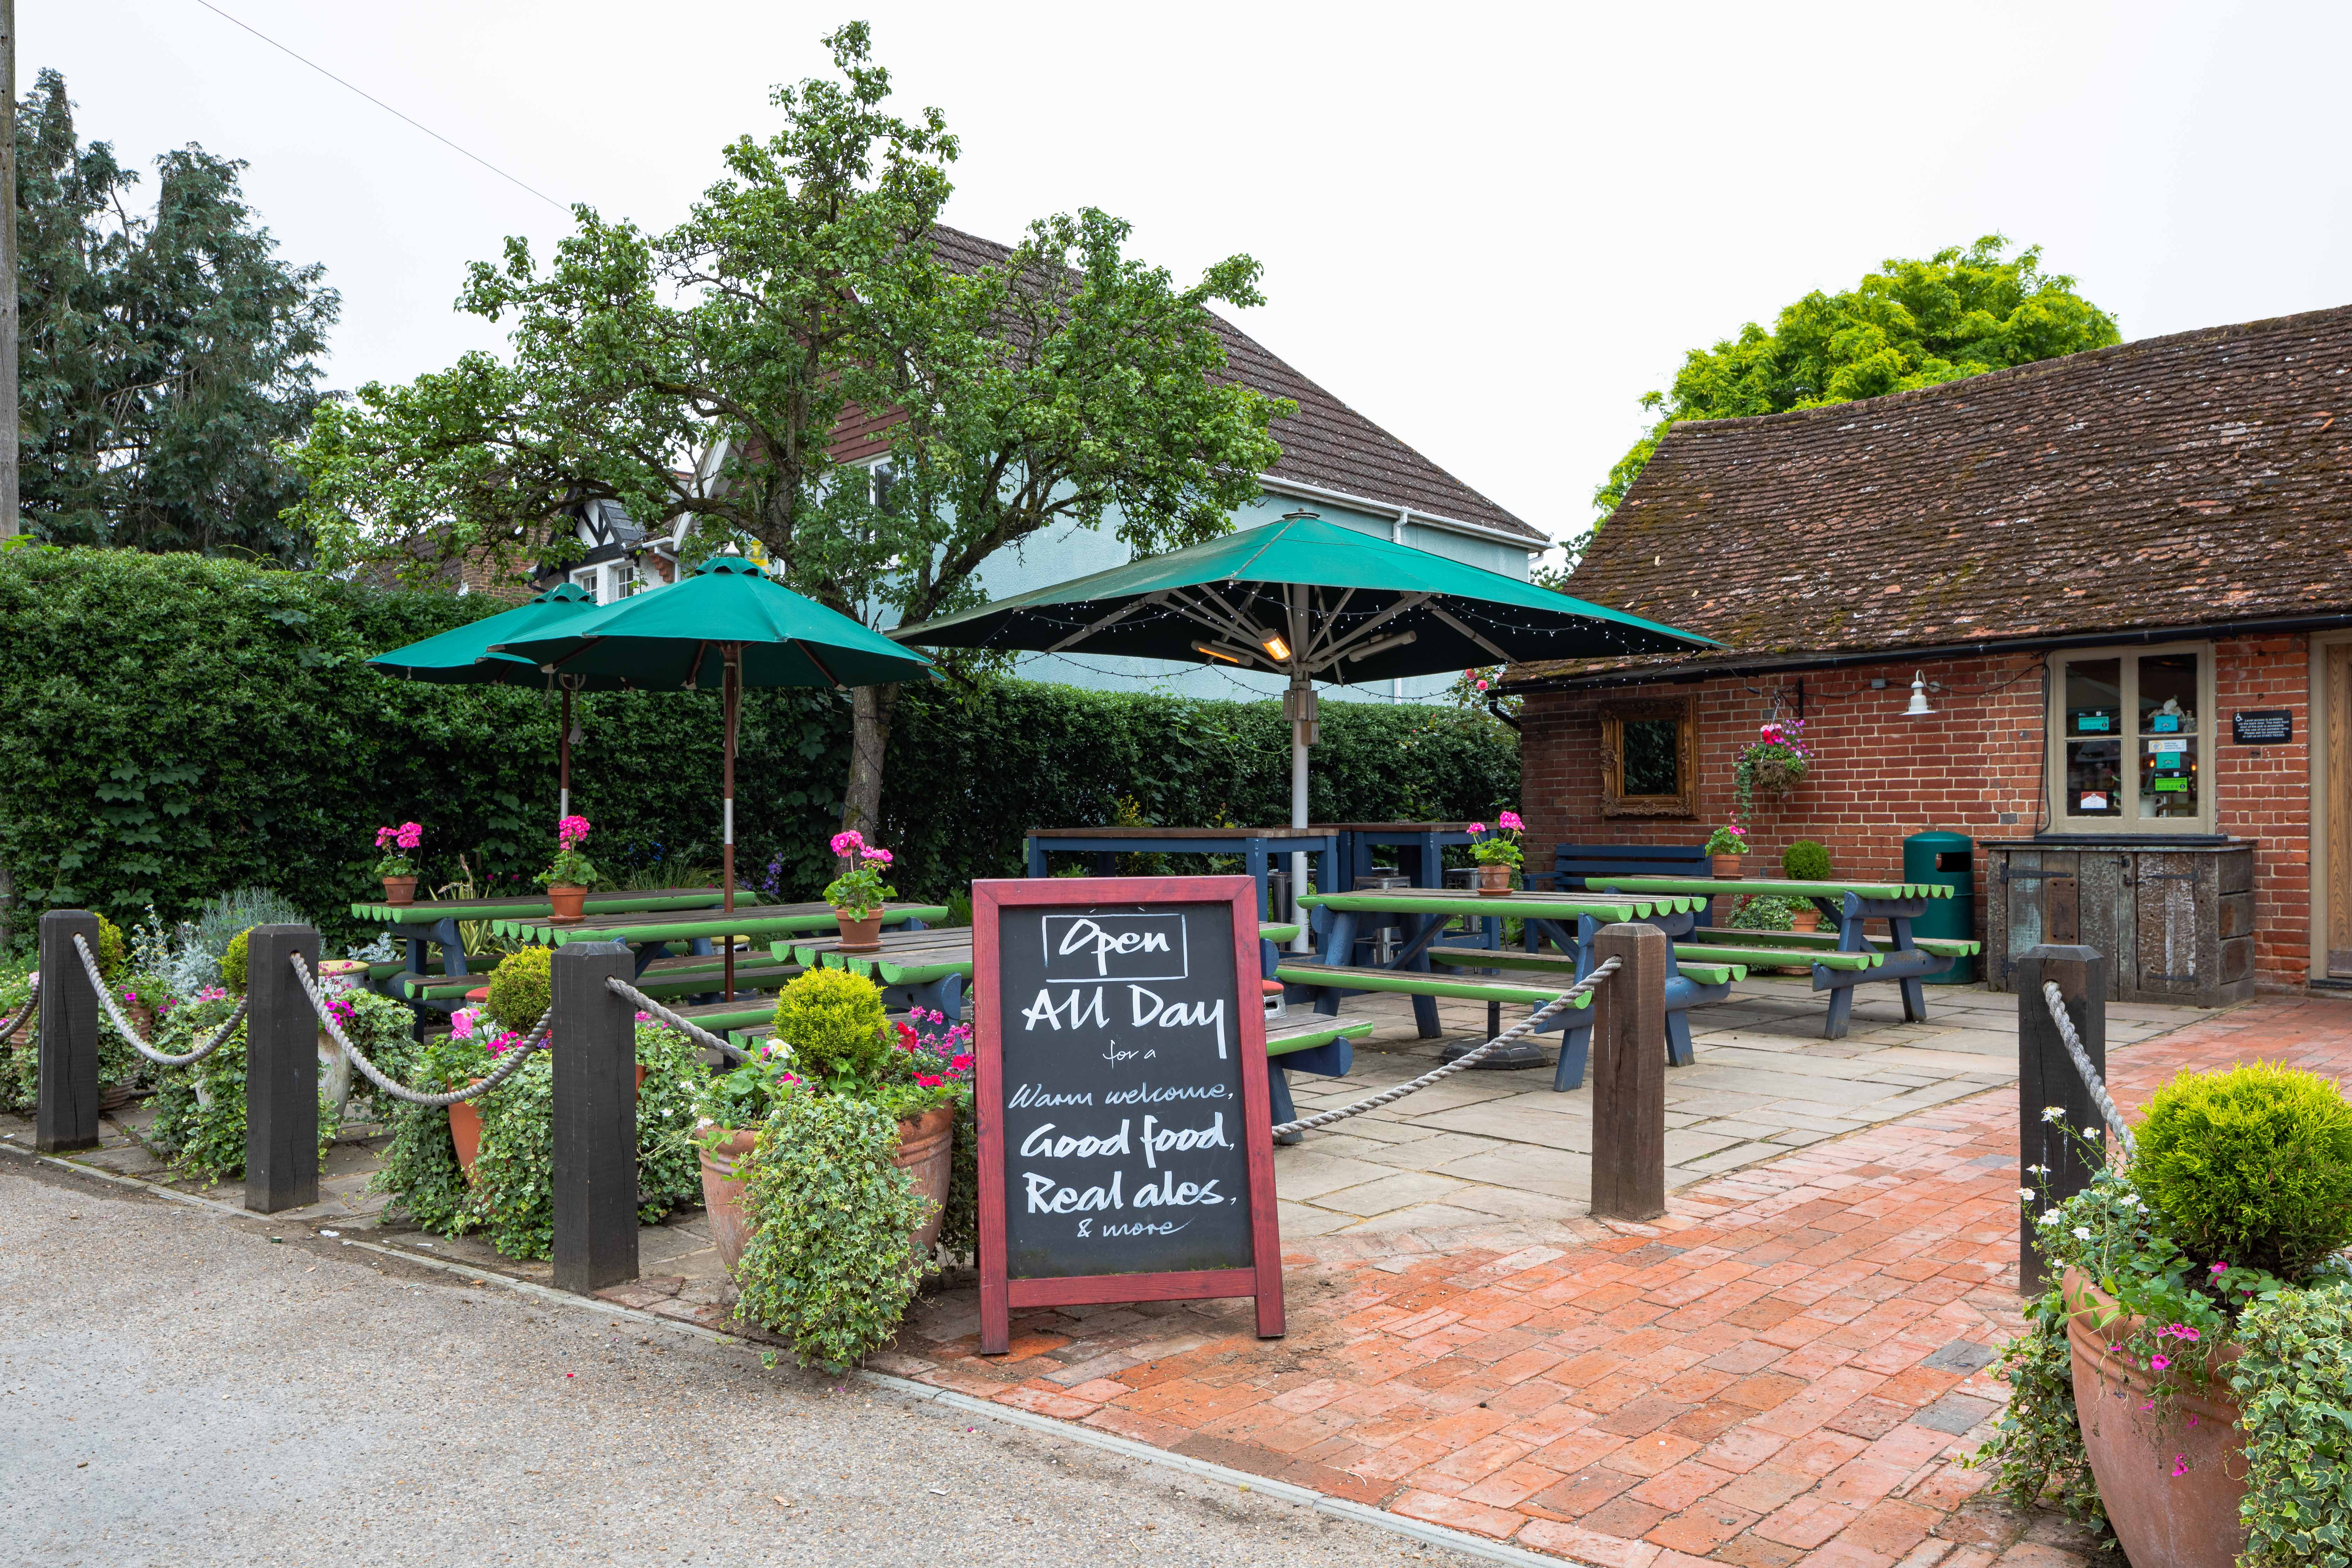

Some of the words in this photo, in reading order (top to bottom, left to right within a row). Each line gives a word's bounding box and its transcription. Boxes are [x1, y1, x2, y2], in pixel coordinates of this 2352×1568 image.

[1058, 918, 1171, 976] Open
[1022, 986, 1111, 1031] All
[1128, 984, 1227, 1059] Day
[1103, 1039, 1140, 1069] for
[1144, 1049, 1156, 1059] a
[1008, 1083, 1093, 1109] Warm
[1105, 1082, 1234, 1104] welcome,
[1020, 1119, 1130, 1158] Good
[1140, 1111, 1235, 1169] food,
[1022, 1171, 1124, 1214] Real
[1133, 1171, 1237, 1208] ales,
[1077, 1218, 1093, 1237] &
[1103, 1217, 1194, 1237] more
